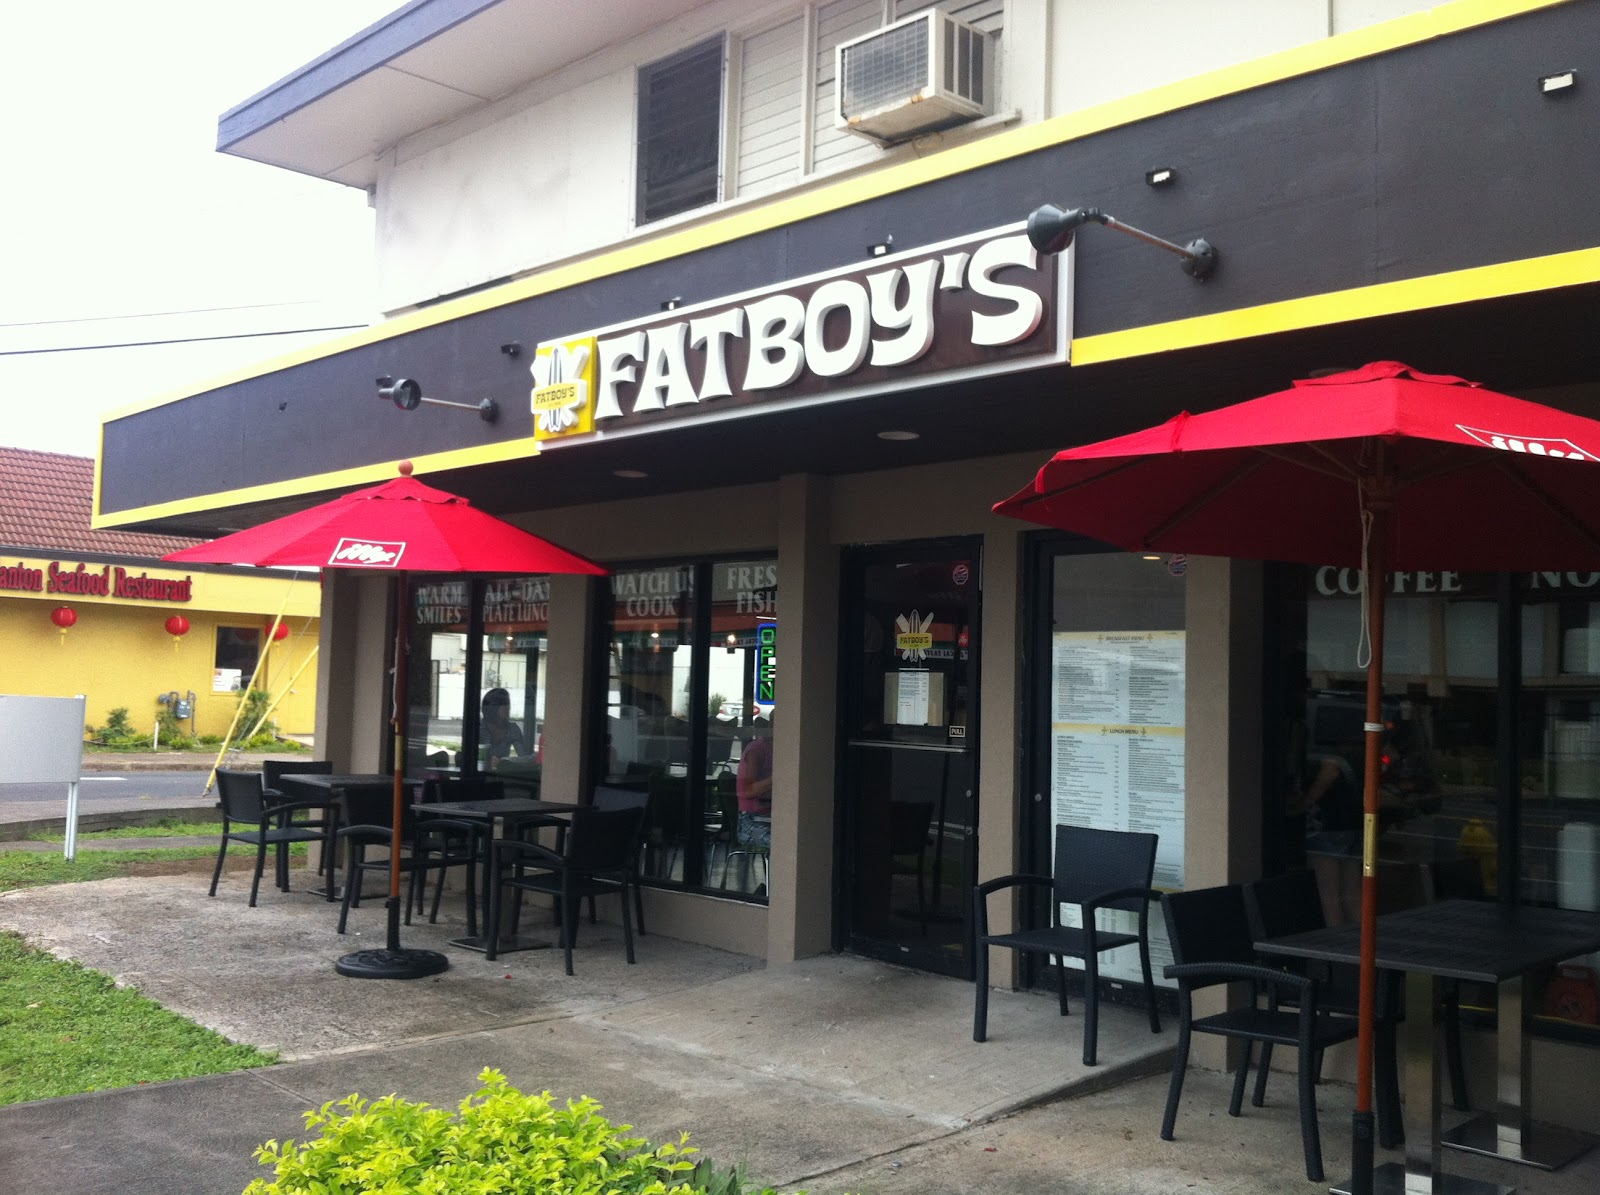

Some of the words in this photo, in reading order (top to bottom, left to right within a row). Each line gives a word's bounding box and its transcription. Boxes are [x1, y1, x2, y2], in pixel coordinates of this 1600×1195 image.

[594, 234, 1043, 420] FATBOY'S
[535, 386, 576, 405] FATBOY'S
[47, 561, 110, 596] Seafood
[113, 566, 192, 602] Restaurant
[611, 571, 670, 595] WATCH
[1315, 565, 1462, 595] COFEE
[417, 585, 463, 604] WARM
[626, 595, 677, 617] COOK
[735, 591, 777, 614] FISH
[416, 606, 462, 624] SMILES
[482, 604, 515, 622] PLATE
[517, 603, 549, 622] LUNC
[760, 628, 775, 700] OPEN
